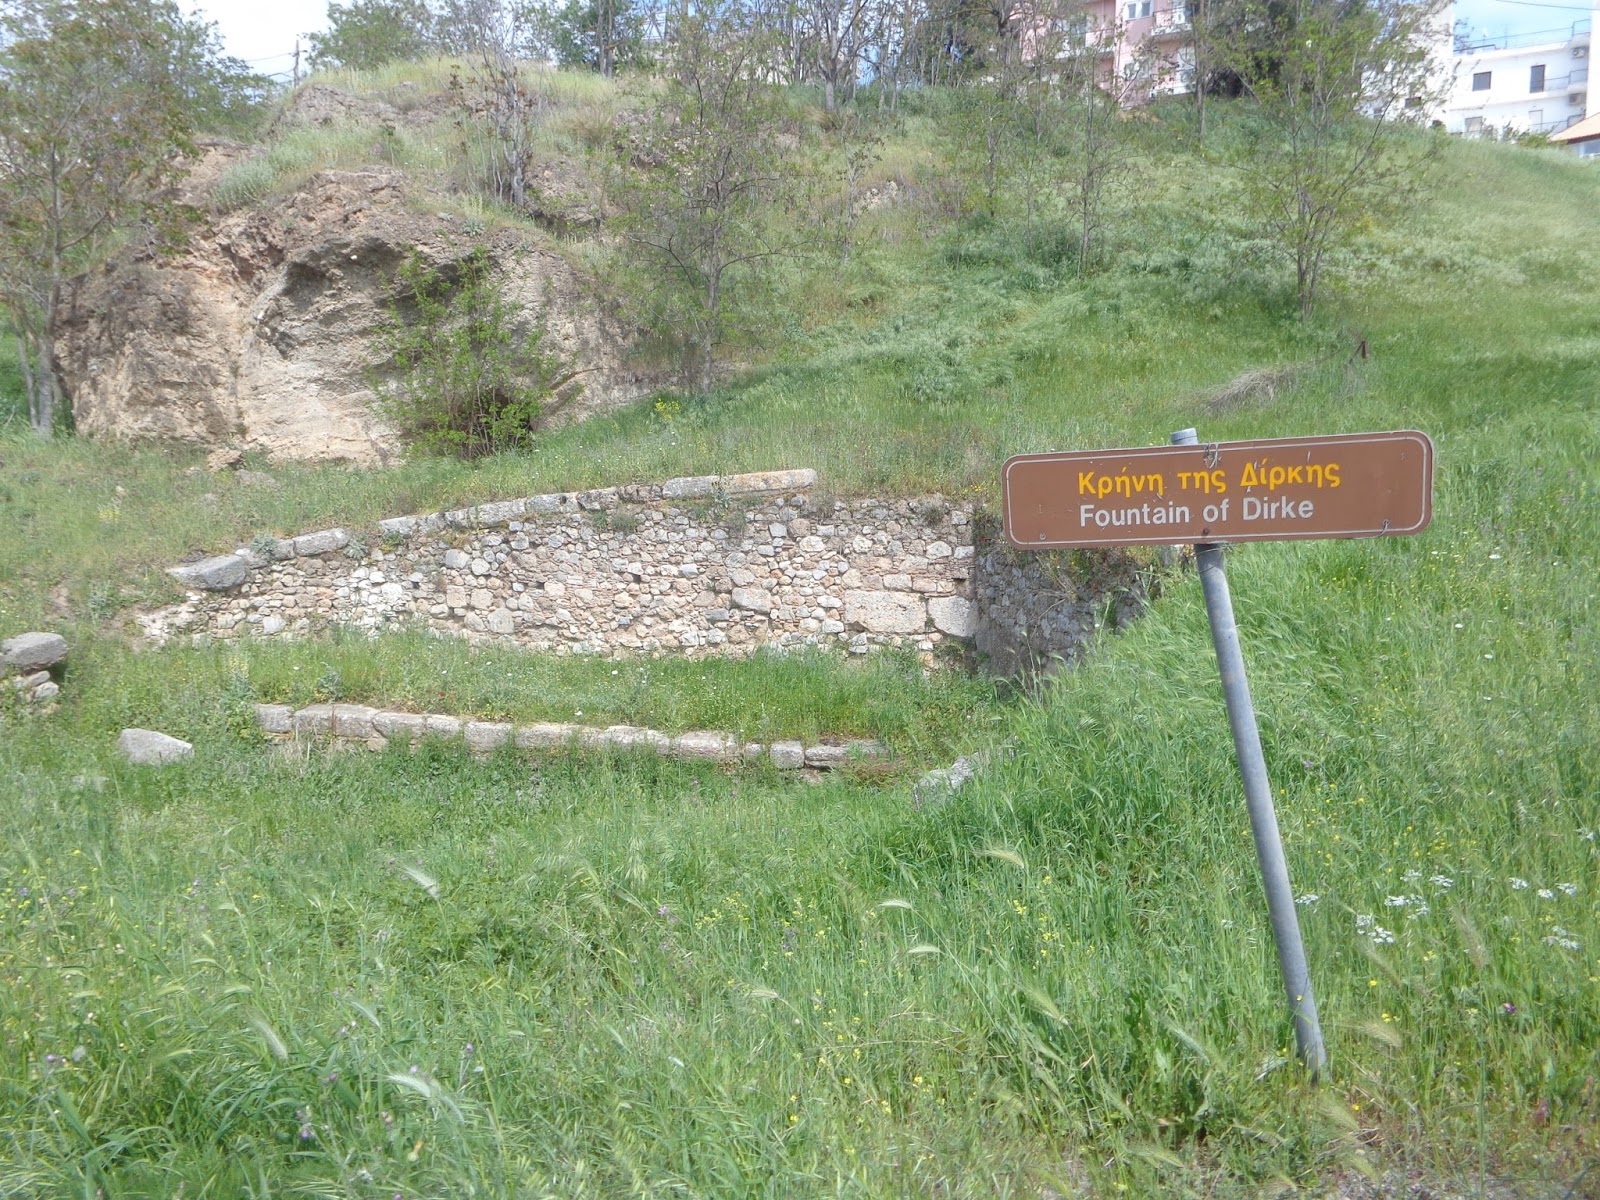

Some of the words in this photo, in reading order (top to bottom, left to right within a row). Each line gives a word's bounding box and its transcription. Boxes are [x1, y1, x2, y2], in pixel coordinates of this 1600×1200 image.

[1079, 466, 1163, 498] Κρήνη
[1177, 469, 1227, 493] της
[1240, 458, 1341, 489] Δίρκης
[1079, 501, 1190, 527] Fountain
[1202, 498, 1230, 523] of
[1242, 495, 1314, 521] Dirke
